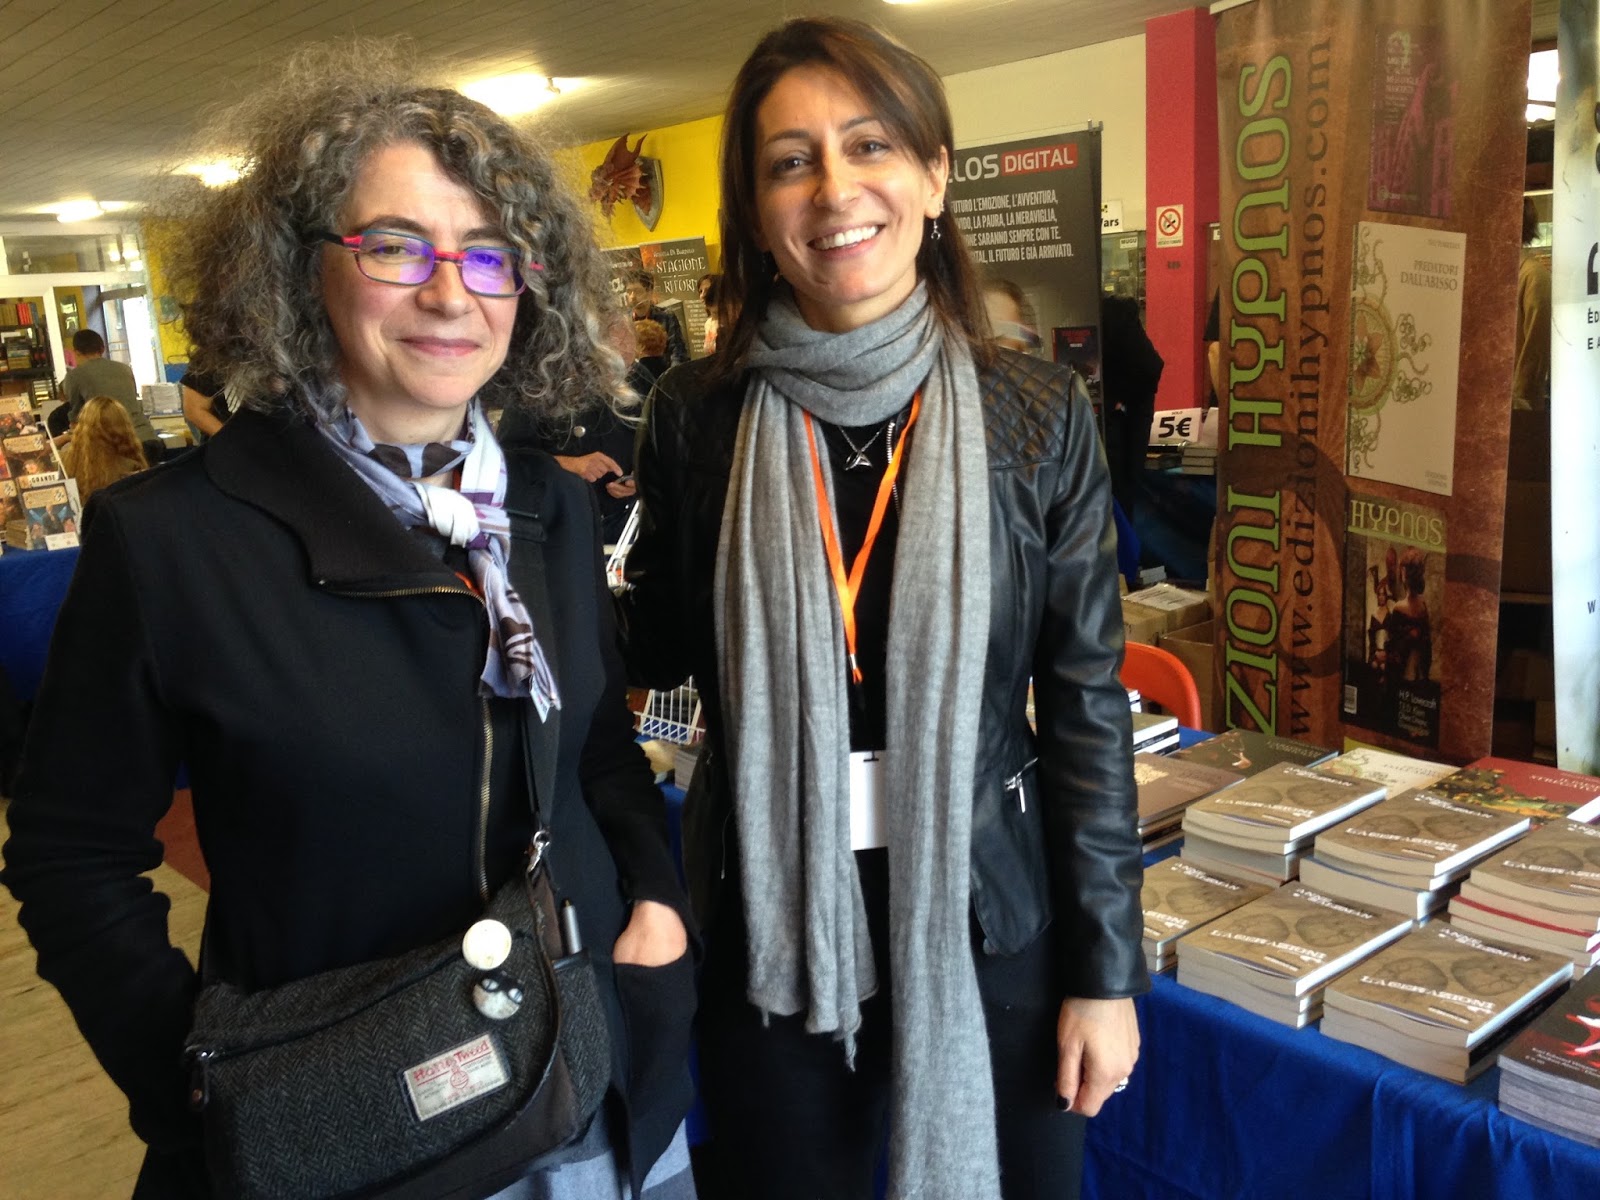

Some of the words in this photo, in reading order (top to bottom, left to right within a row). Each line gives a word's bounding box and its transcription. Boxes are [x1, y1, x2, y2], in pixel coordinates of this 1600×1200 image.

[949, 154, 999, 183] LOS
[1004, 147, 1074, 173] DIGITAL
[973, 194, 1011, 212] L'EMOZIONE,
[1012, 189, 1058, 207] L'AVVENTURA,
[973, 215, 982, 229] LA
[982, 213, 1005, 228] PAURA,
[1006, 212, 1015, 226] LA
[1015, 208, 1057, 225] MERAVIGLIA,
[978, 230, 1008, 246] SARANNO
[1008, 228, 1035, 243] SEMPRE
[1035, 226, 1050, 241] CON
[988, 250, 995, 263] IL
[995, 247, 1020, 262] FUTURO
[1038, 243, 1074, 259] ARRIVATO.
[1228, 55, 1292, 451] HYPNOS
[656, 257, 706, 274] STAGIONE
[1285, 37, 1331, 736] www.edizionihypnos.com
[1158, 416, 1192, 438] 5€
[1350, 500, 1443, 546] HYPNOS
[453, 1040, 489, 1062] Tweed
